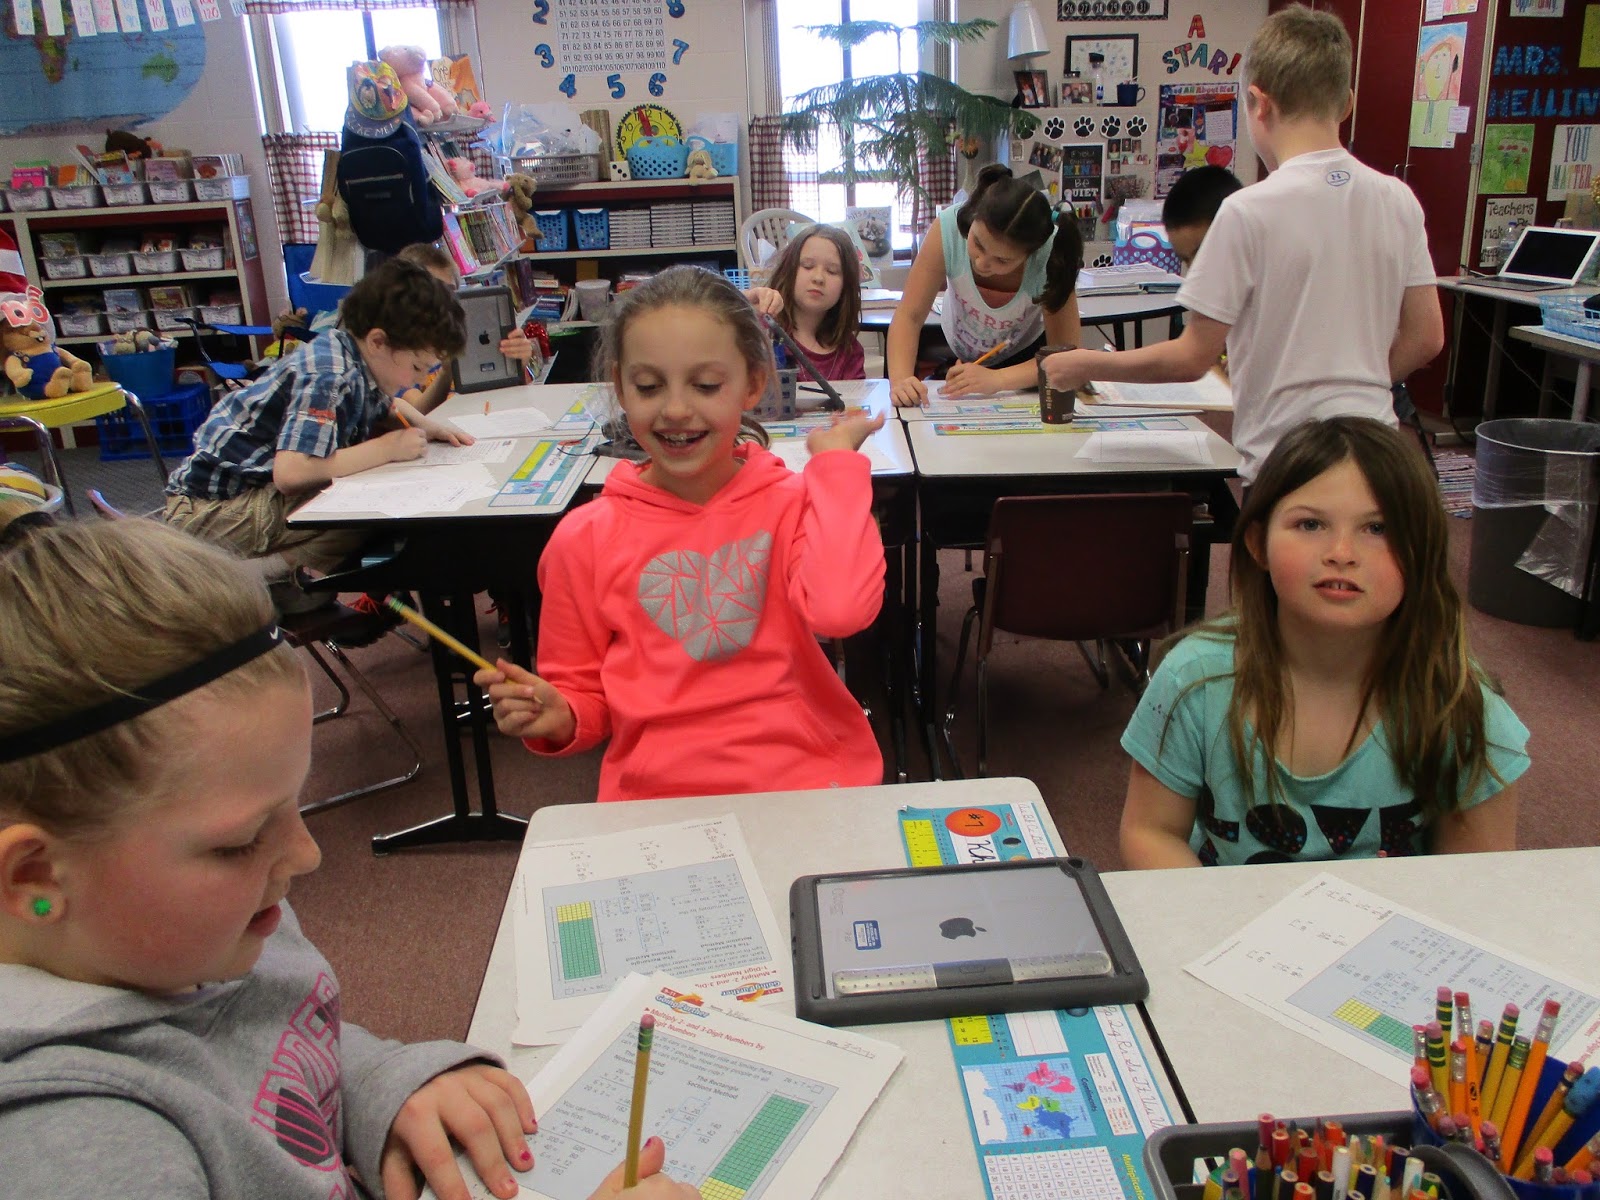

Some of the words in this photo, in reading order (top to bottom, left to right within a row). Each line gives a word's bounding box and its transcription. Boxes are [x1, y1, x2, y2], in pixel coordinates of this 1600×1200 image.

[532, 0, 550, 25] 2
[666, 0, 685, 18] 8
[1187, 14, 1206, 39] A
[534, 44, 554, 68] 3
[672, 38, 690, 65] 7
[1162, 42, 1242, 76] STAR!
[1493, 45, 1568, 76] MRS.
[559, 74, 576, 98] 4
[606, 74, 626, 99] 5
[648, 72, 667, 96] 6
[624, 123, 633, 132] 10
[668, 122, 674, 130] 2
[621, 136, 626, 144] 9
[1564, 126, 1592, 162] YOU
[1552, 164, 1592, 190] MATTER
[1488, 202, 1534, 216] Teachers
[1484, 226, 1502, 239] mak
[710, 970, 742, 979] Numbers
[741, 971, 770, 982] Multiply
[745, 966, 768, 974] 1-Digit
[720, 985, 757, 996] Further
[756, 980, 781, 991] Going
[655, 994, 682, 1011] Going
[680, 1002, 710, 1018] Further
[650, 1008, 680, 1024] Multiply
[686, 1020, 700, 1031] and
[700, 1024, 724, 1040] 3-Digit
[725, 1032, 755, 1048] Numbers
[756, 1040, 765, 1051] by
[668, 1023, 697, 1038] Numbers
[699, 1048, 716, 1058] water
[716, 1053, 729, 1061] ride
[687, 1080, 712, 1094] Sections
[713, 1088, 739, 1100] Method
[697, 1074, 709, 1083] The
[710, 1078, 739, 1092] Rectangle
[1081, 1078, 1097, 1112] Continents
